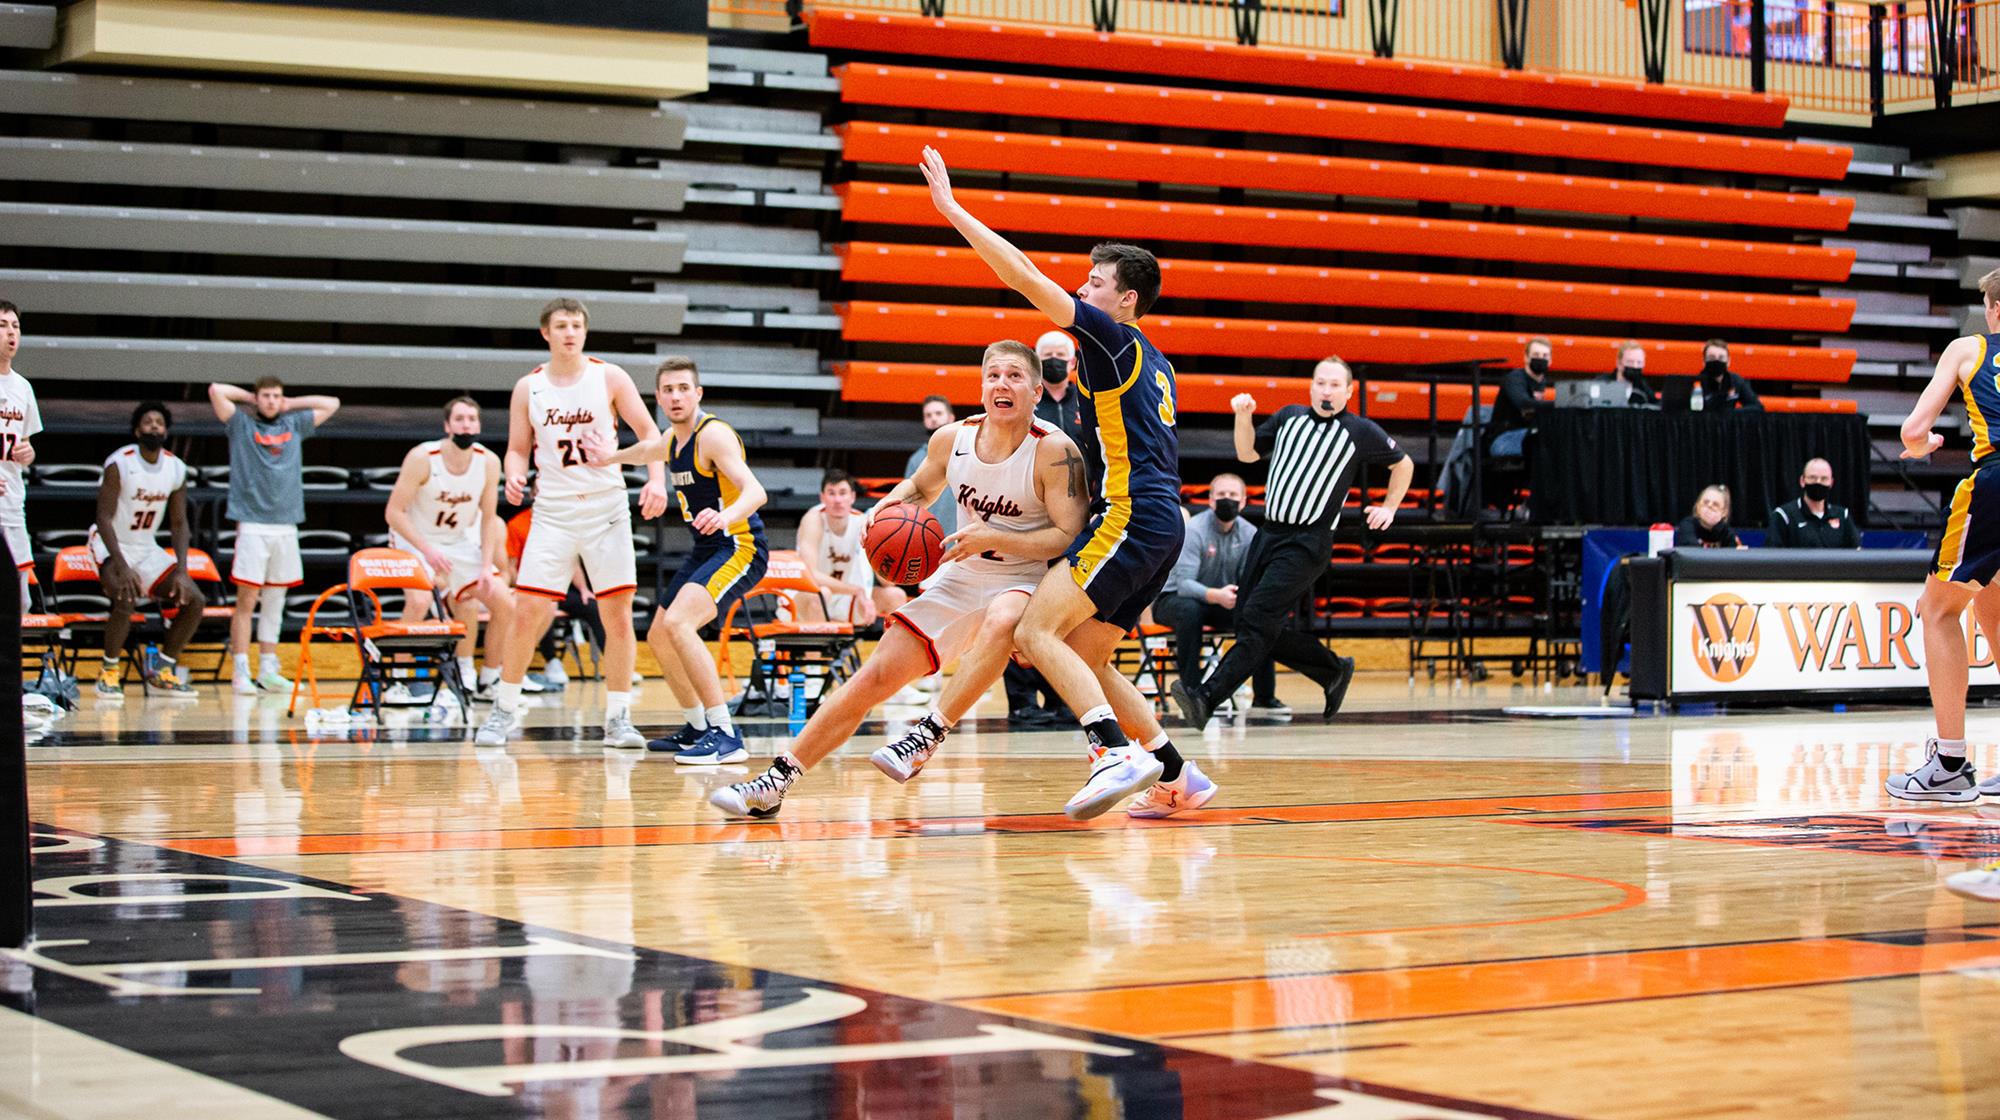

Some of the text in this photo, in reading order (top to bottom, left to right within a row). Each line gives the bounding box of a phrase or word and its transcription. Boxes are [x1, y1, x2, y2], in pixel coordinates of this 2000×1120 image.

[1155, 369, 1176, 427] 3
[543, 408, 595, 433] Knights
[957, 483, 1023, 522] Knights
[130, 510, 156, 531] 30
[435, 510, 458, 529] 14
[1697, 633, 1756, 661] Knights
[1773, 600, 1996, 672] WARB
